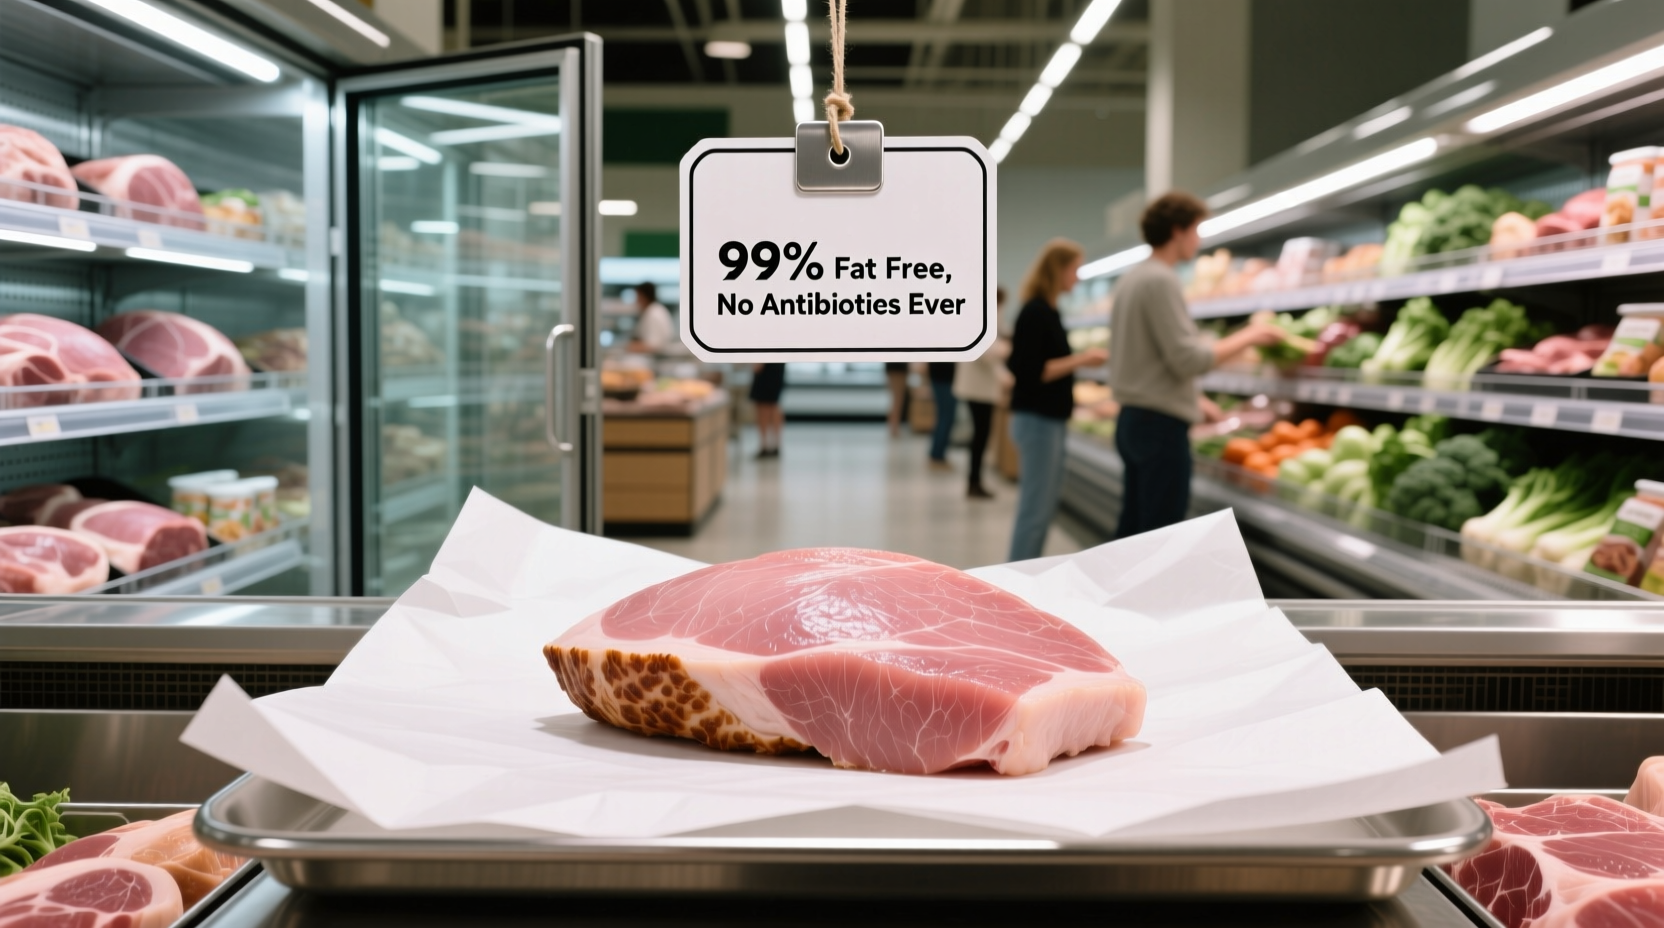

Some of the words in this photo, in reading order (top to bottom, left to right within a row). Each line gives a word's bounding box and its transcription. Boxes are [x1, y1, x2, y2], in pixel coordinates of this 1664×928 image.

[718, 240, 824, 281] 99%
[835, 256, 877, 280] Fat
[886, 256, 952, 284] Free,
[717, 292, 754, 316] No
[760, 291, 901, 316] Antibioties
[909, 292, 966, 316] Ever
